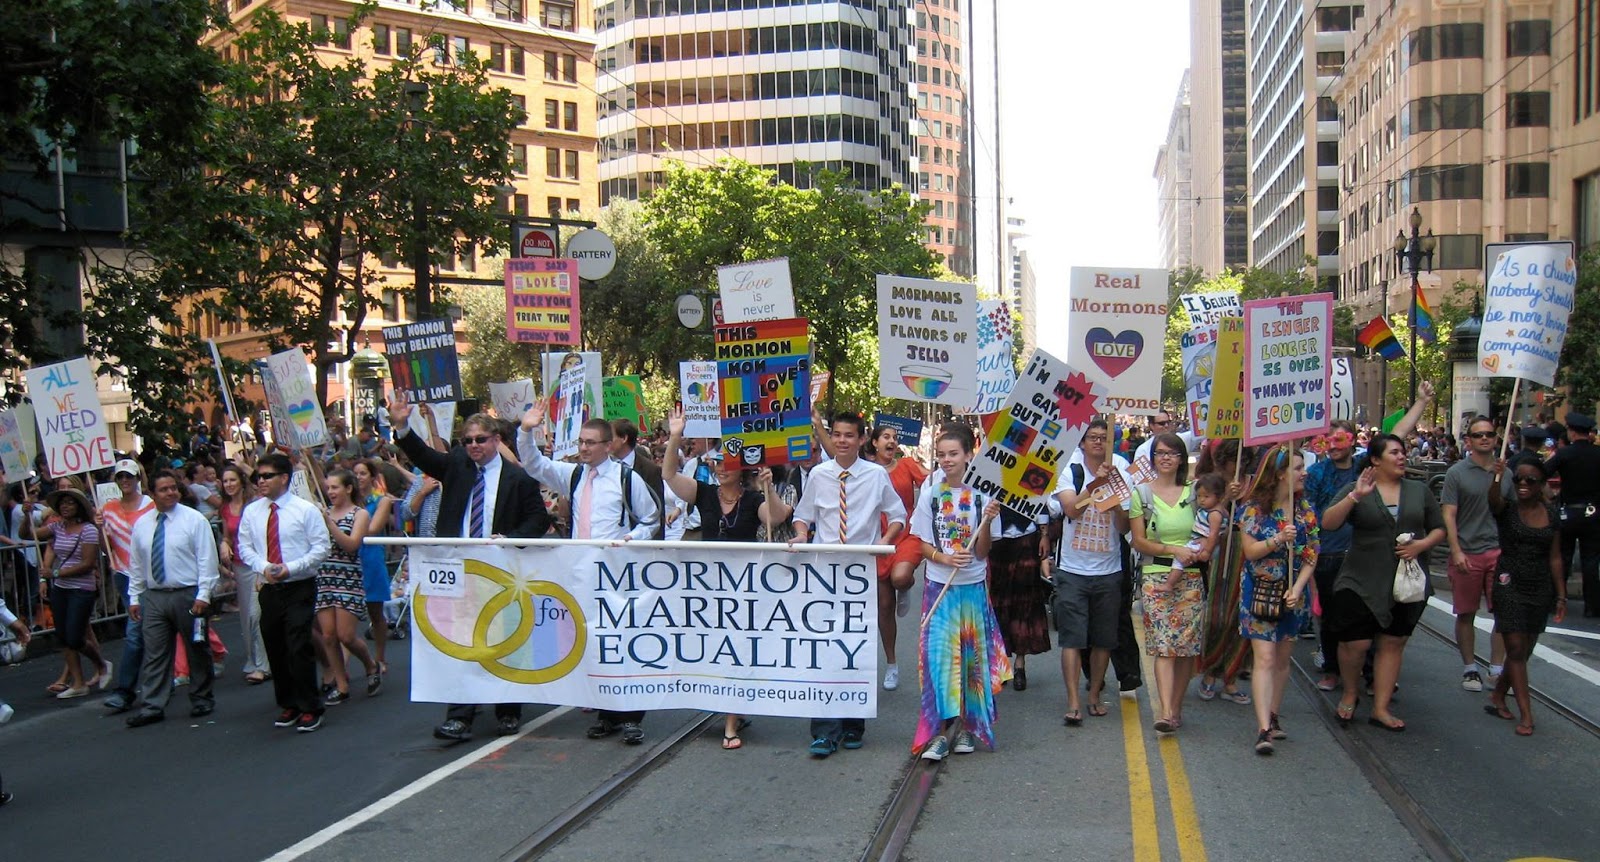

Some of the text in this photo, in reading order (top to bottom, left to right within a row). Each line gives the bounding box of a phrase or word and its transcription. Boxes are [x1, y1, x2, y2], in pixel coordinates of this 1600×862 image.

[525, 238, 551, 248] DO NOT
[572, 250, 612, 259] BATTERY
[526, 276, 557, 288] LOVE
[729, 270, 774, 293] Love
[1094, 273, 1142, 289] Real
[513, 295, 572, 308] EVERYONE
[752, 291, 763, 302] is
[891, 286, 963, 305] MORMONS
[1183, 297, 1200, 312] I
[1490, 282, 1542, 308] nobody
[743, 303, 776, 316] never
[890, 305, 957, 323] LOVE ALL
[1070, 298, 1168, 315] Mormons
[1277, 301, 1304, 316] THE
[1485, 306, 1505, 323] be
[516, 312, 542, 322] TREAT
[383, 320, 446, 340] THIS MORMON
[717, 326, 757, 342] THIS
[890, 324, 968, 344] FLAVORS OF
[1262, 316, 1320, 338] LINGER
[386, 333, 455, 355] JUST BELIEVES
[718, 340, 792, 359] MORMON
[907, 344, 949, 363] JELLO
[1094, 343, 1136, 357] LOVE
[1261, 337, 1317, 361] LONGER
[42, 363, 79, 391] ALL
[728, 359, 767, 376] MOM
[1263, 361, 1282, 377] IS
[418, 389, 427, 401] IS
[431, 384, 454, 400] LOVE
[1053, 380, 1085, 406] NOT
[1252, 378, 1324, 400] THANK YOU
[52, 392, 79, 413] WE
[727, 397, 802, 418] HER GAY
[46, 409, 97, 436] NEED
[1010, 402, 1042, 427] BUT
[1255, 401, 1326, 428] SCOTUS
[65, 429, 85, 444] IS
[51, 436, 112, 475] LOVE
[985, 446, 1017, 470] AND
[972, 477, 1005, 502] LOVE
[429, 570, 456, 585] 029
[594, 560, 870, 595] MORMONS
[535, 597, 570, 627] for
[594, 595, 868, 634] MARRIAGE
[595, 632, 868, 670] EQUALITY
[599, 680, 868, 705] mormonsformarriageequality.org
